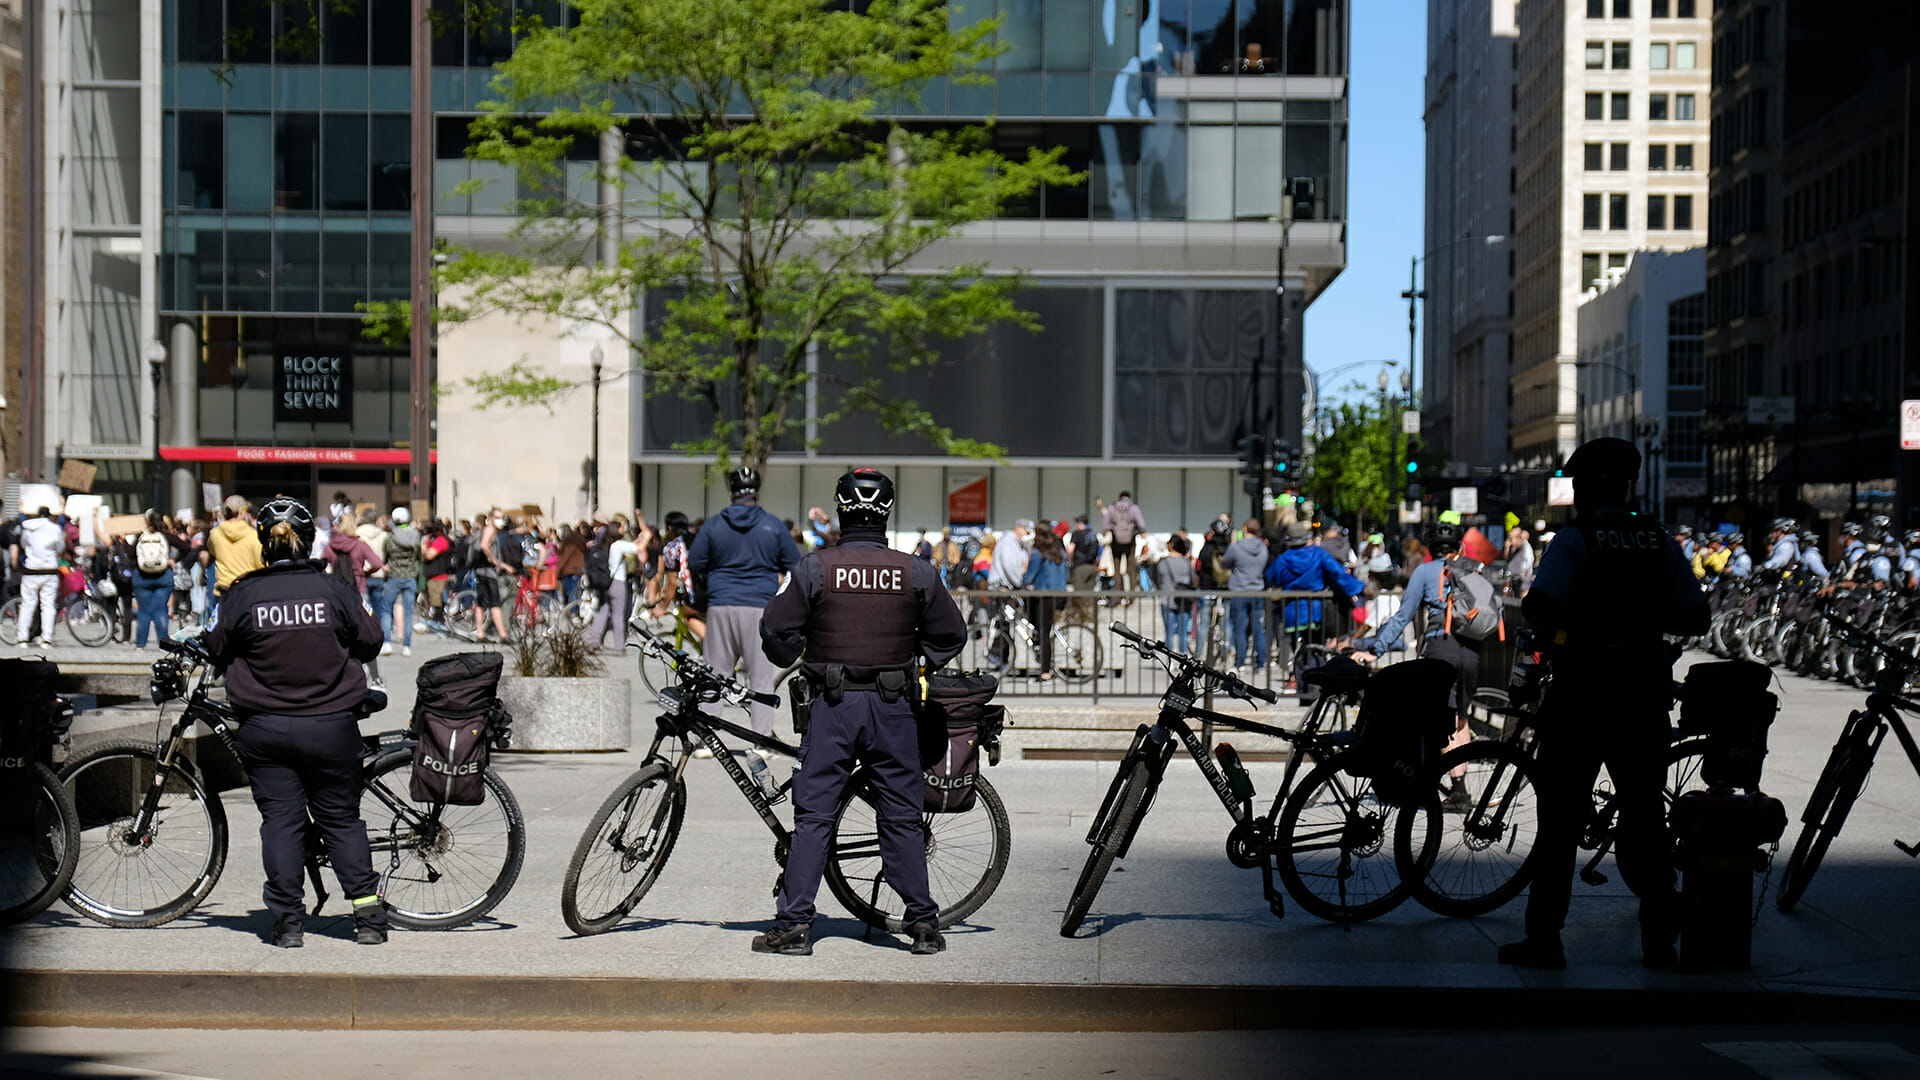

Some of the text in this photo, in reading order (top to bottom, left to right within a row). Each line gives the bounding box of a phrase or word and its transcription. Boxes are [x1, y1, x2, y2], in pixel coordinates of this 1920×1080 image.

[283, 356, 341, 374] BLOCK
[284, 374, 341, 391] THIRTY
[283, 391, 339, 409] SEVEN
[237, 449, 354, 461] FOOD FASHION FILMS
[1595, 529, 1660, 551] POLICE
[835, 568, 902, 590] POLICE
[256, 602, 326, 628] POLICE
[214, 723, 243, 764] CHIC
[0, 757, 25, 768] ICE
[423, 755, 479, 776] POLICE
[704, 734, 770, 818] CHICAGO POLICE
[1213, 774, 1240, 812] POLICE
